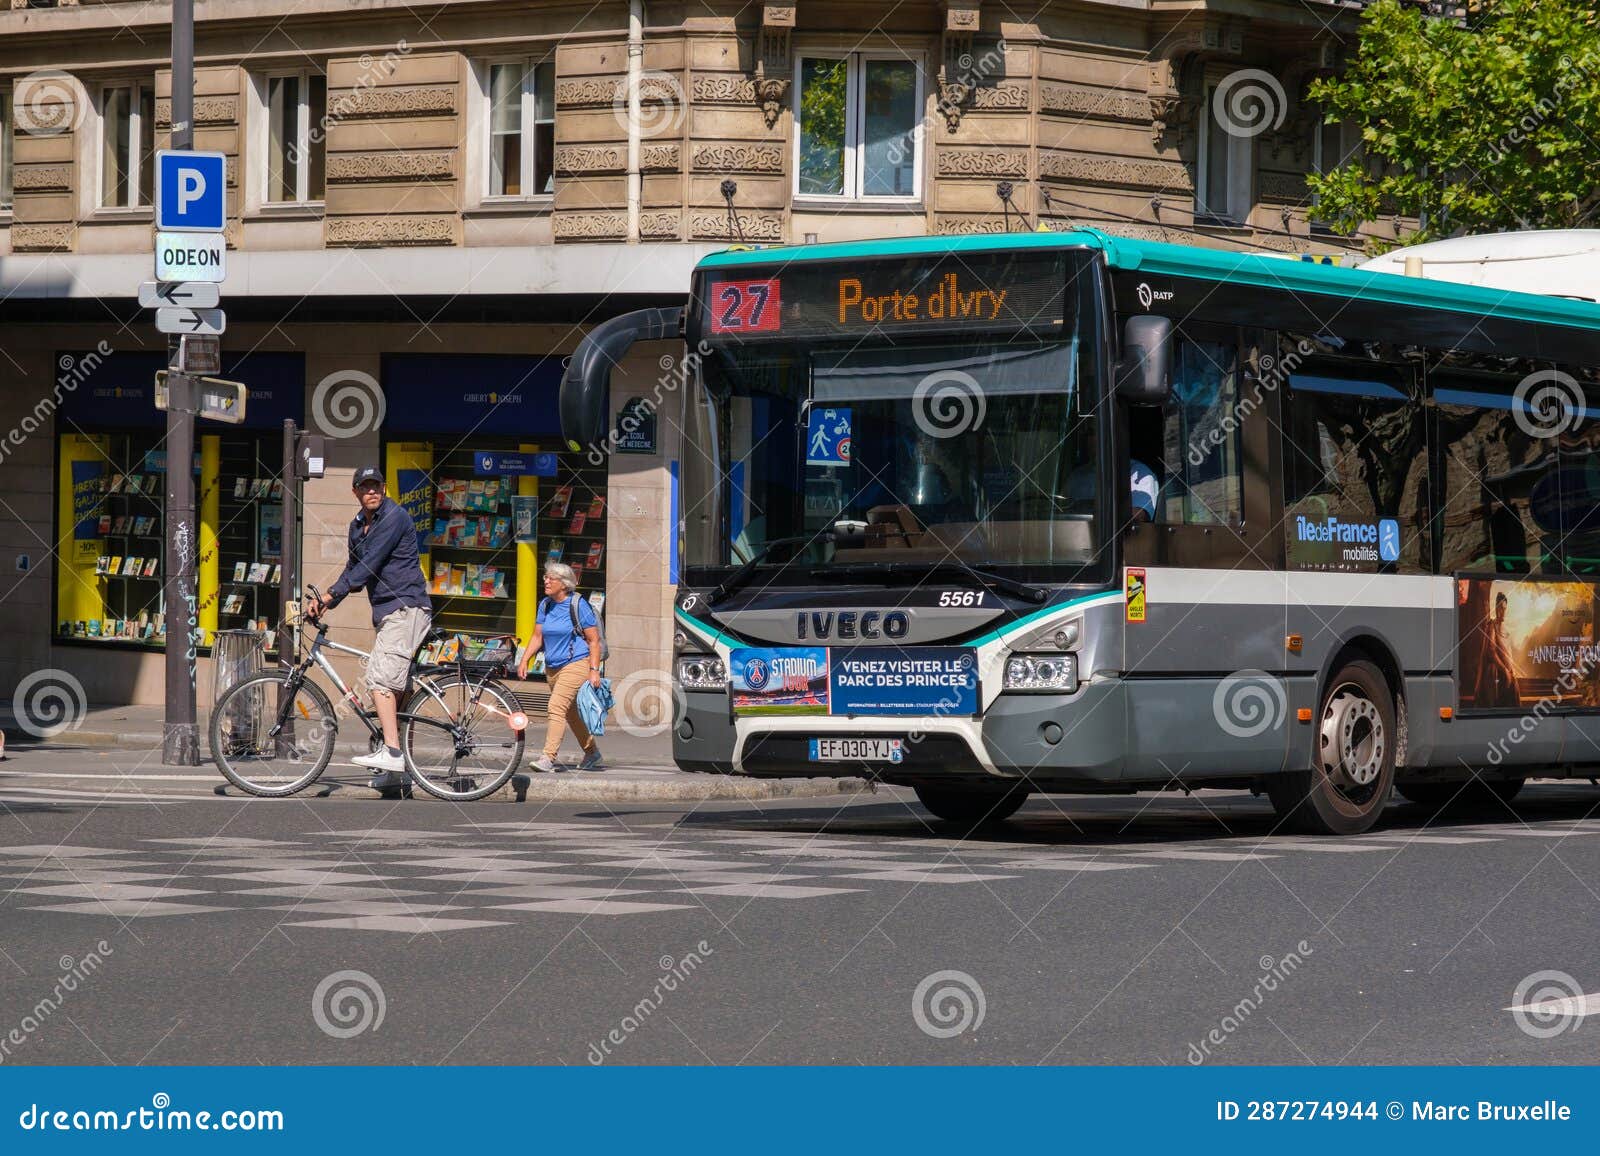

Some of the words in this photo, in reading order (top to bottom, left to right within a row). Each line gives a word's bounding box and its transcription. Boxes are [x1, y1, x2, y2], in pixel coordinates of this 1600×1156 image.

[178, 168, 206, 214] P
[163, 248, 220, 266] ODEON
[839, 278, 918, 324] Porte
[928, 273, 1007, 320] d'Ivry
[1153, 291, 1174, 300] RATP
[720, 285, 770, 328] 27
[1343, 546, 1378, 561] mobilités
[938, 591, 984, 607] 5561
[797, 610, 909, 640] IVECO
[771, 658, 817, 677] STADIUM
[843, 661, 886, 673] VENEZ
[888, 661, 940, 673] VISITER
[945, 661, 962, 673] LE
[783, 674, 809, 692] TOUR
[838, 674, 874, 687] PARC
[876, 674, 903, 687] DES
[906, 674, 967, 687] PRINCES
[820, 740, 890, 758] EF-030-YJ
